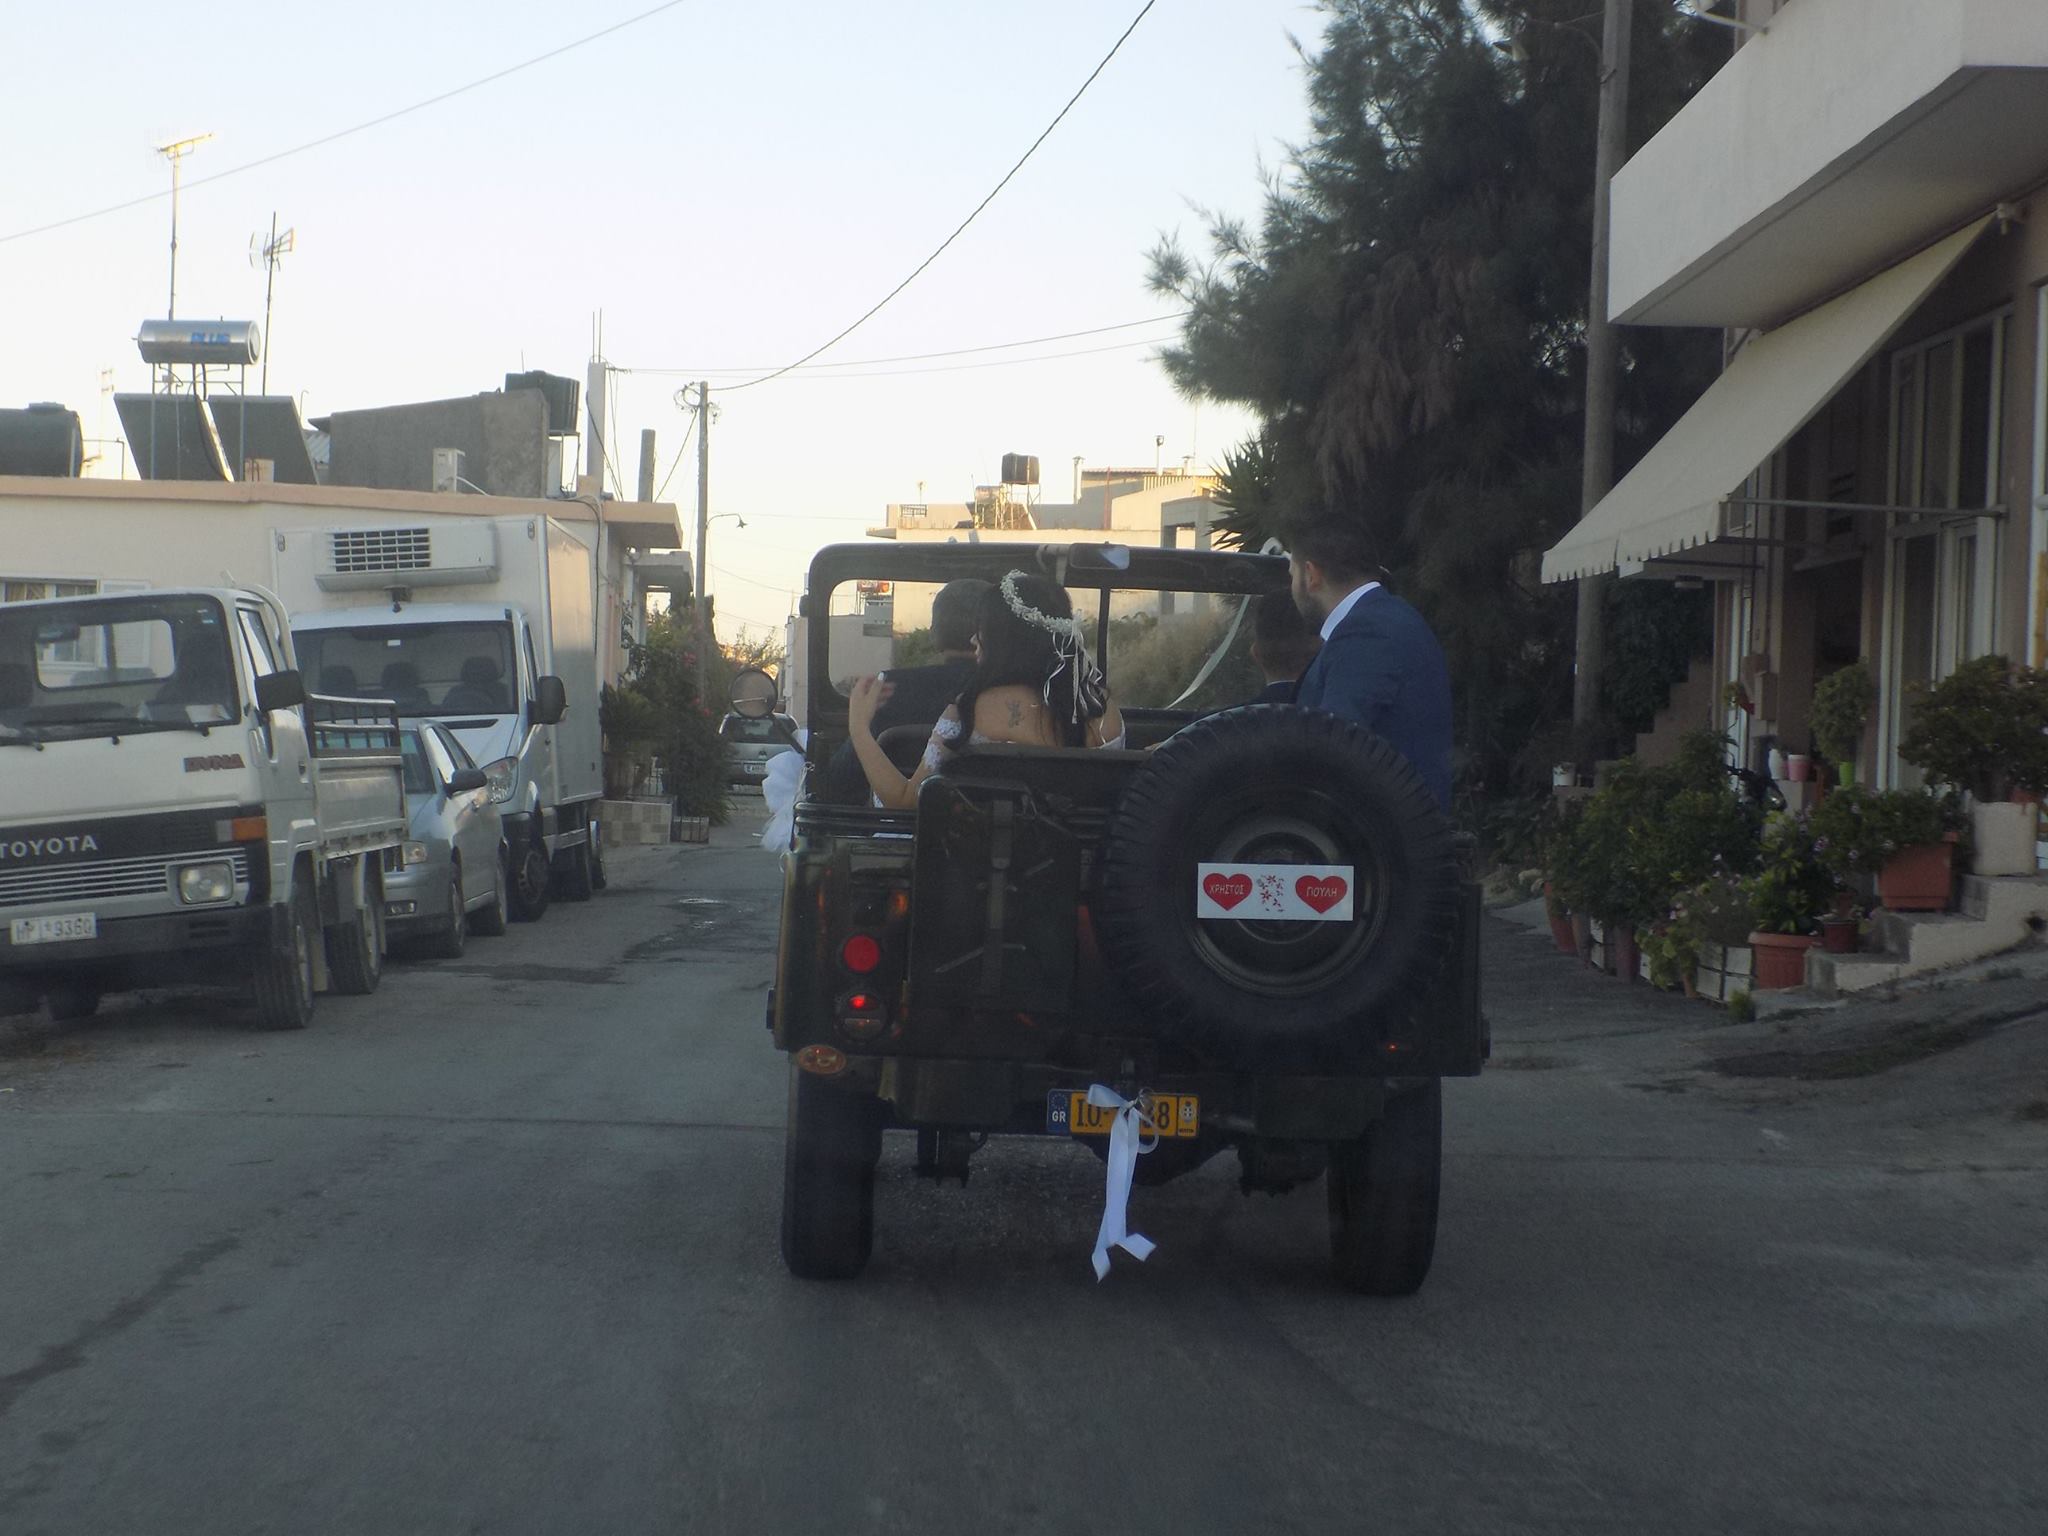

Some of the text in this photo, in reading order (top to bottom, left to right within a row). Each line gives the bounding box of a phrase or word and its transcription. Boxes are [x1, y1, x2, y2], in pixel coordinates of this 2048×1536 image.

[0, 835, 98, 858] TOYOTA
[1209, 883, 1245, 895] ΧΡΗΣΤΟΣ
[1052, 1110, 1066, 1122] GR
